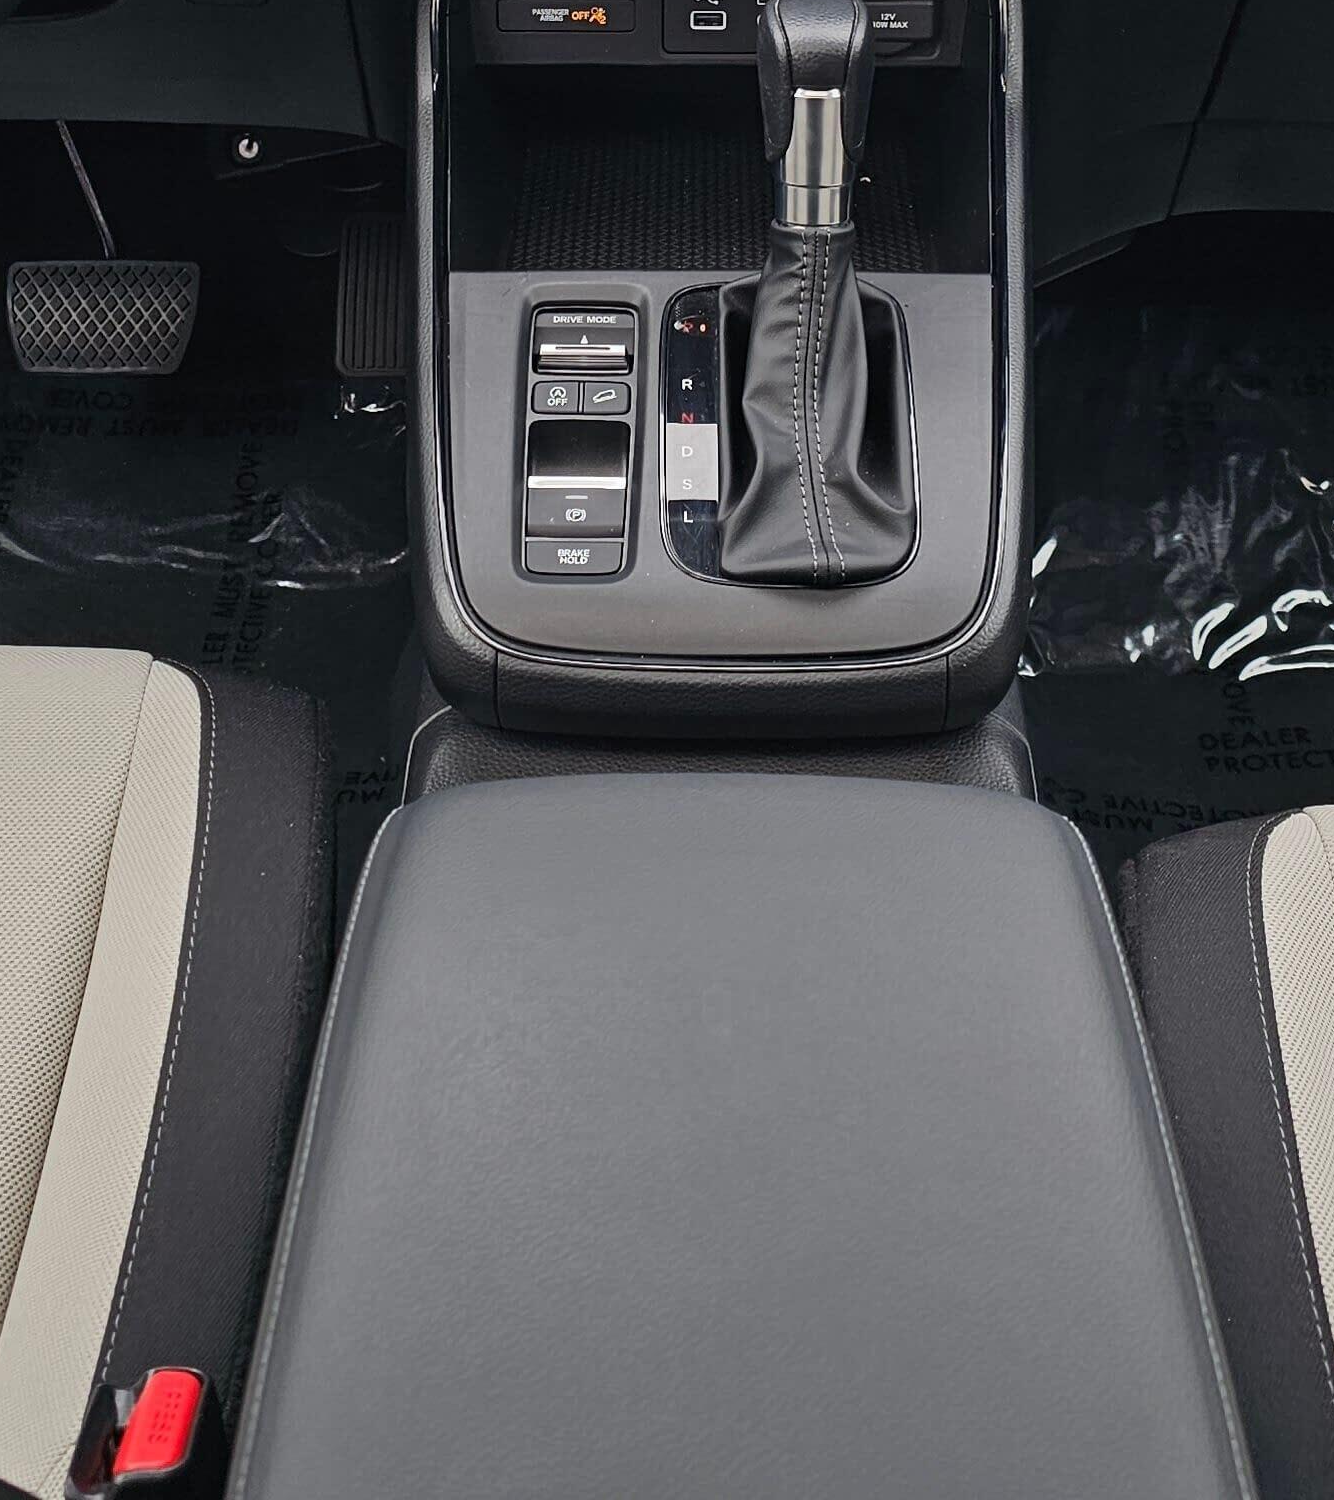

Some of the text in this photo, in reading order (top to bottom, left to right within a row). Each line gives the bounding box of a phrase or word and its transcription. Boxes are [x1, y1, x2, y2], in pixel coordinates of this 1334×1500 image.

[571, 11, 590, 20] OFF
[553, 315, 617, 324] DRIVE MODE
[681, 379, 693, 390] R
[547, 398, 568, 407] OFF
[681, 412, 694, 423] N
[681, 446, 693, 457] D
[682, 478, 693, 490] S
[683, 511, 694, 523] L
[557, 549, 590, 557] BRAKE
[559, 556, 588, 565] HOLD
[1198, 726, 1312, 752] DEALER
